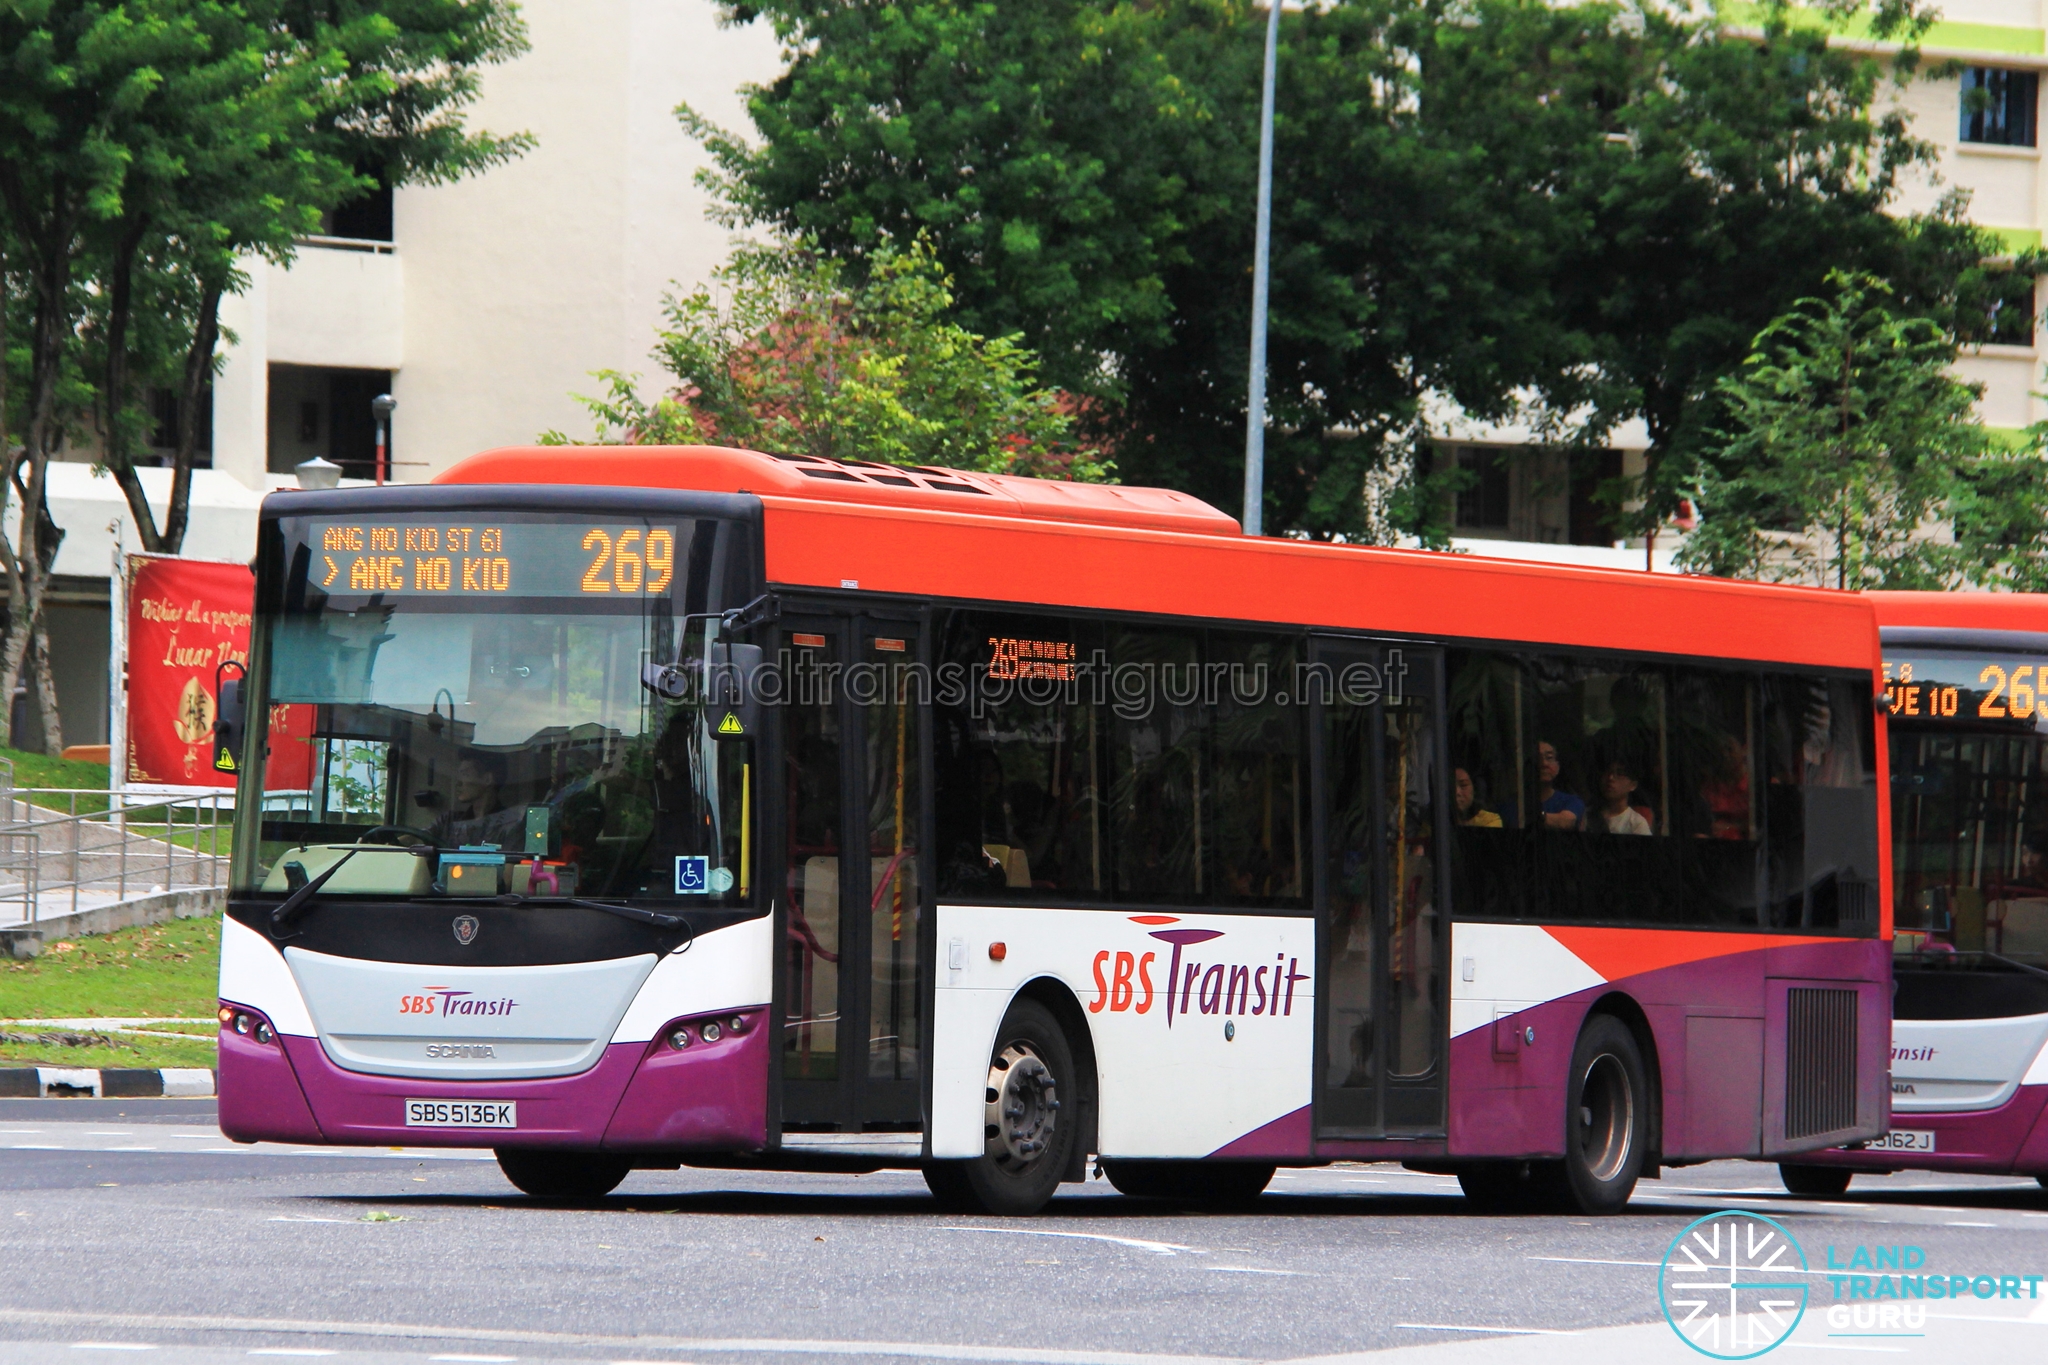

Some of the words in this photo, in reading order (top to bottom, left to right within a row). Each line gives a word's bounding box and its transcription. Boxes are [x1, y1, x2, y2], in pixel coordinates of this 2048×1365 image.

[323, 527, 364, 551] ANG
[370, 527, 398, 551] MO
[405, 528, 439, 552] KIO
[446, 528, 474, 552] ST
[480, 528, 502, 552] 61
[350, 556, 404, 590] ANG
[415, 557, 451, 591] MO
[462, 557, 509, 591] KIO
[581, 528, 673, 593] 269
[162, 635, 213, 669] Lunar
[989, 637, 1018, 680] 269
[1900, 663, 1913, 684] 8
[1929, 687, 1959, 717] 10
[1978, 665, 2047, 719] 265
[1088, 949, 1155, 1015] SBS
[1147, 928, 1312, 1031] Transit
[399, 995, 435, 1015] SBS
[433, 991, 521, 1018] Transit
[426, 1043, 498, 1059] SCANIA
